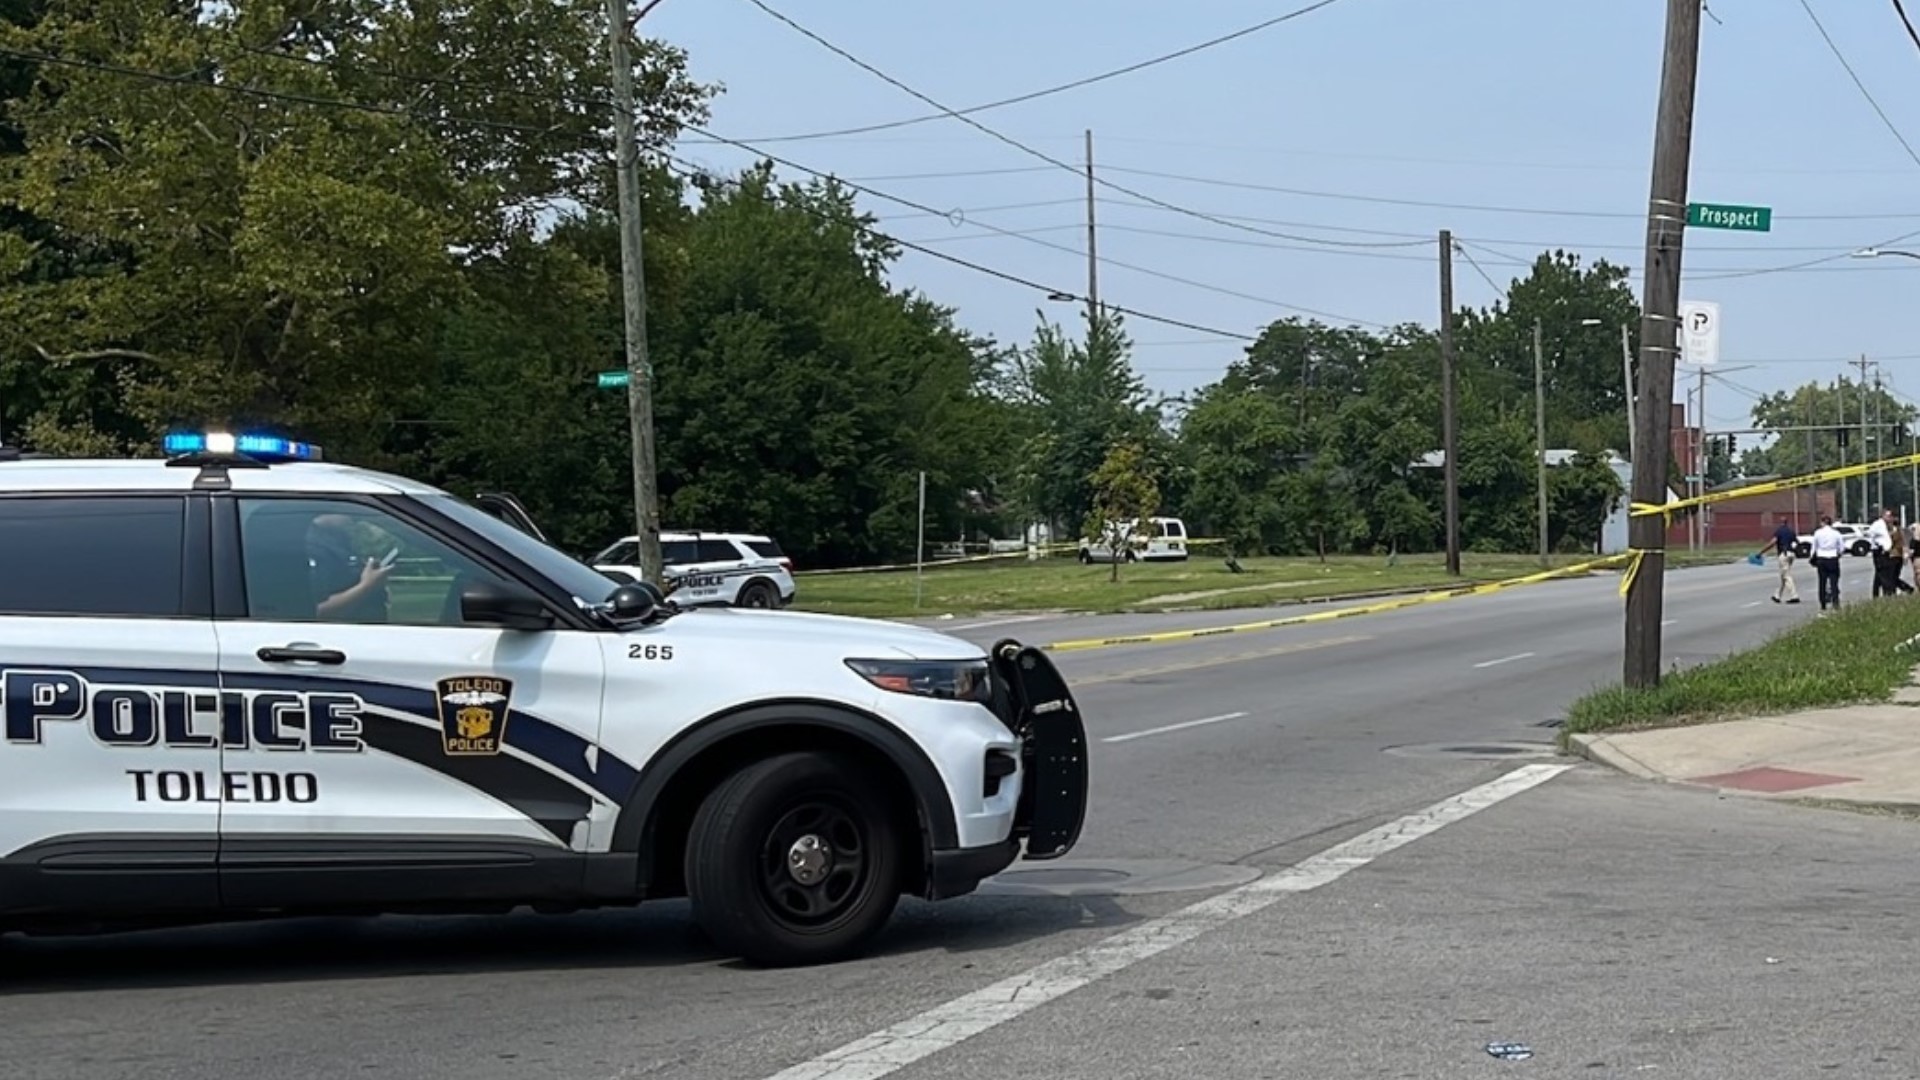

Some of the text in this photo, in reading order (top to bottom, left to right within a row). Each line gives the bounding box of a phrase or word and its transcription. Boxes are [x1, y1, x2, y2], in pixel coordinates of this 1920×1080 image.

[1700, 206, 1759, 227] Prospect
[628, 644, 674, 660] 265
[446, 679, 504, 692] TOLEDO
[448, 738, 494, 751] POLICE
[126, 770, 318, 803] TOLEDO
